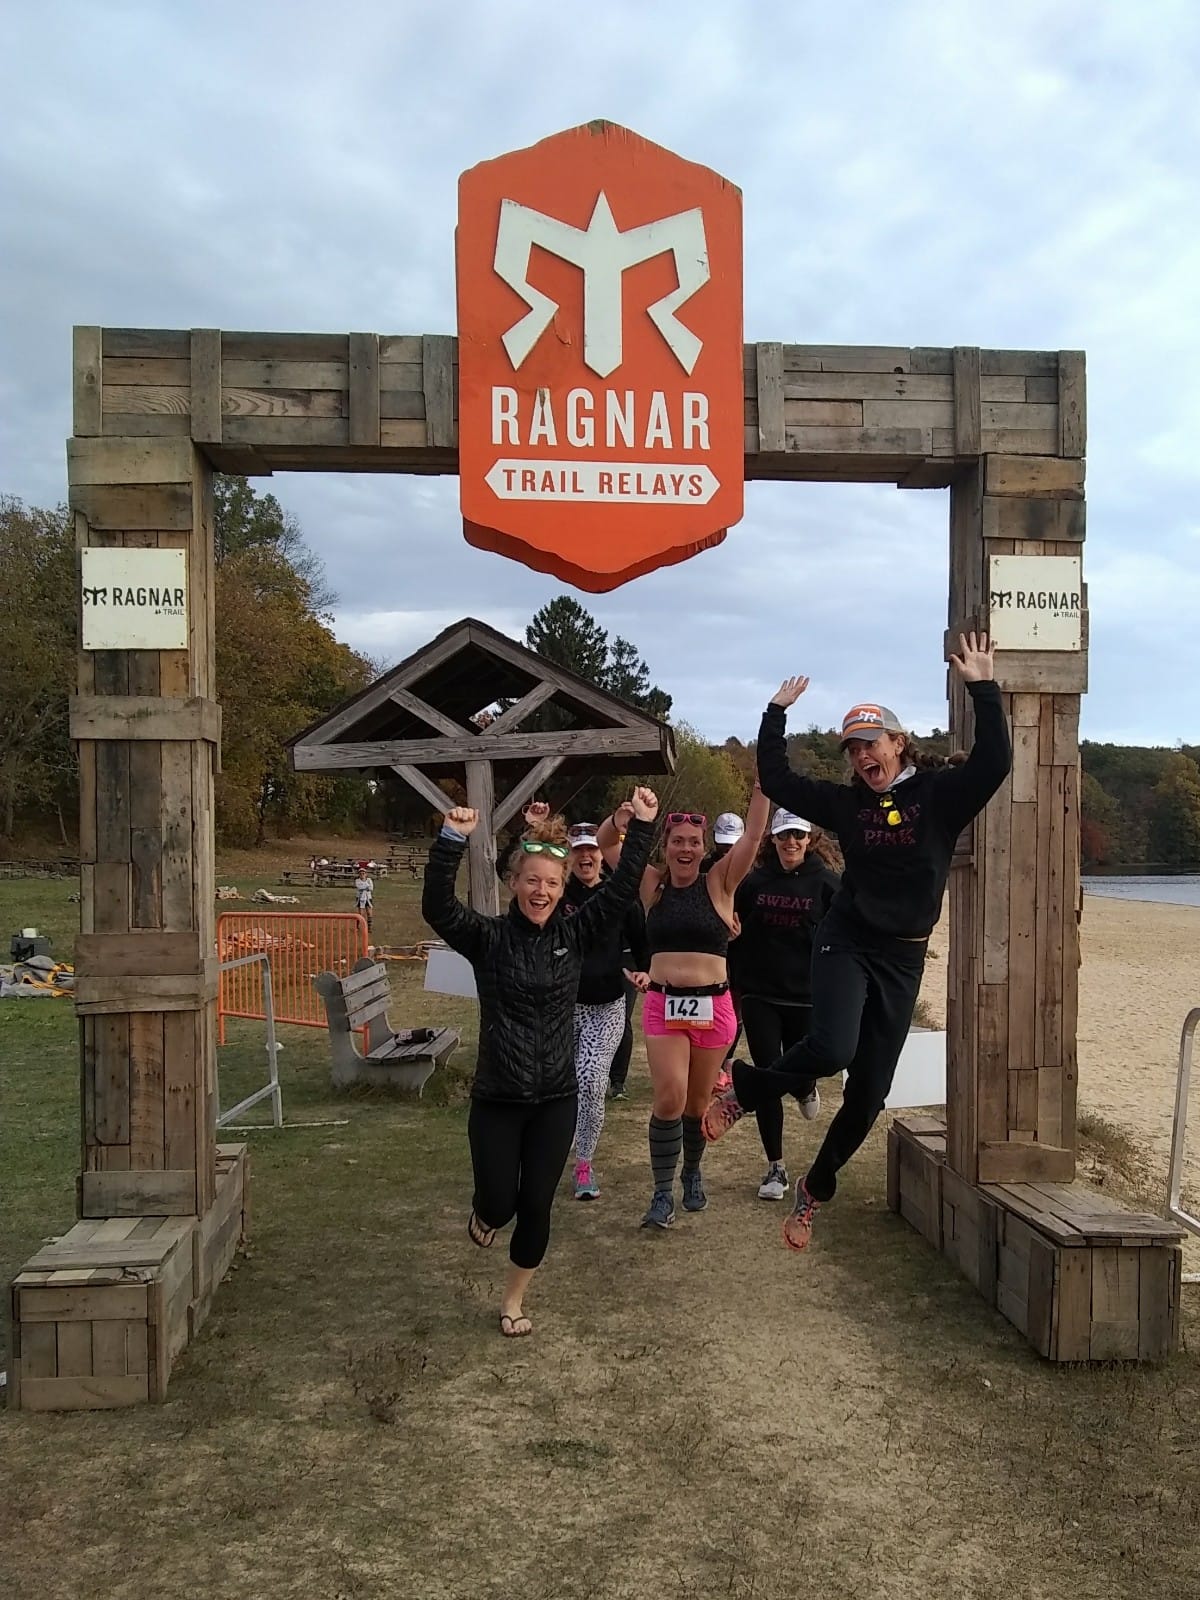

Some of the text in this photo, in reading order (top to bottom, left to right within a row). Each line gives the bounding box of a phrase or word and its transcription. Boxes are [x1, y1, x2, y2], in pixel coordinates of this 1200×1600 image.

[491, 386, 711, 450] RAGNAR
[502, 469, 703, 497] TRAIL RELAYS
[112, 587, 184, 606] RAGNAR
[1016, 591, 1080, 610] RAGNAR
[163, 608, 184, 616] TRAIL
[856, 804, 920, 825] SWAT
[756, 893, 815, 911] SWEAT
[668, 999, 699, 1016] 142
